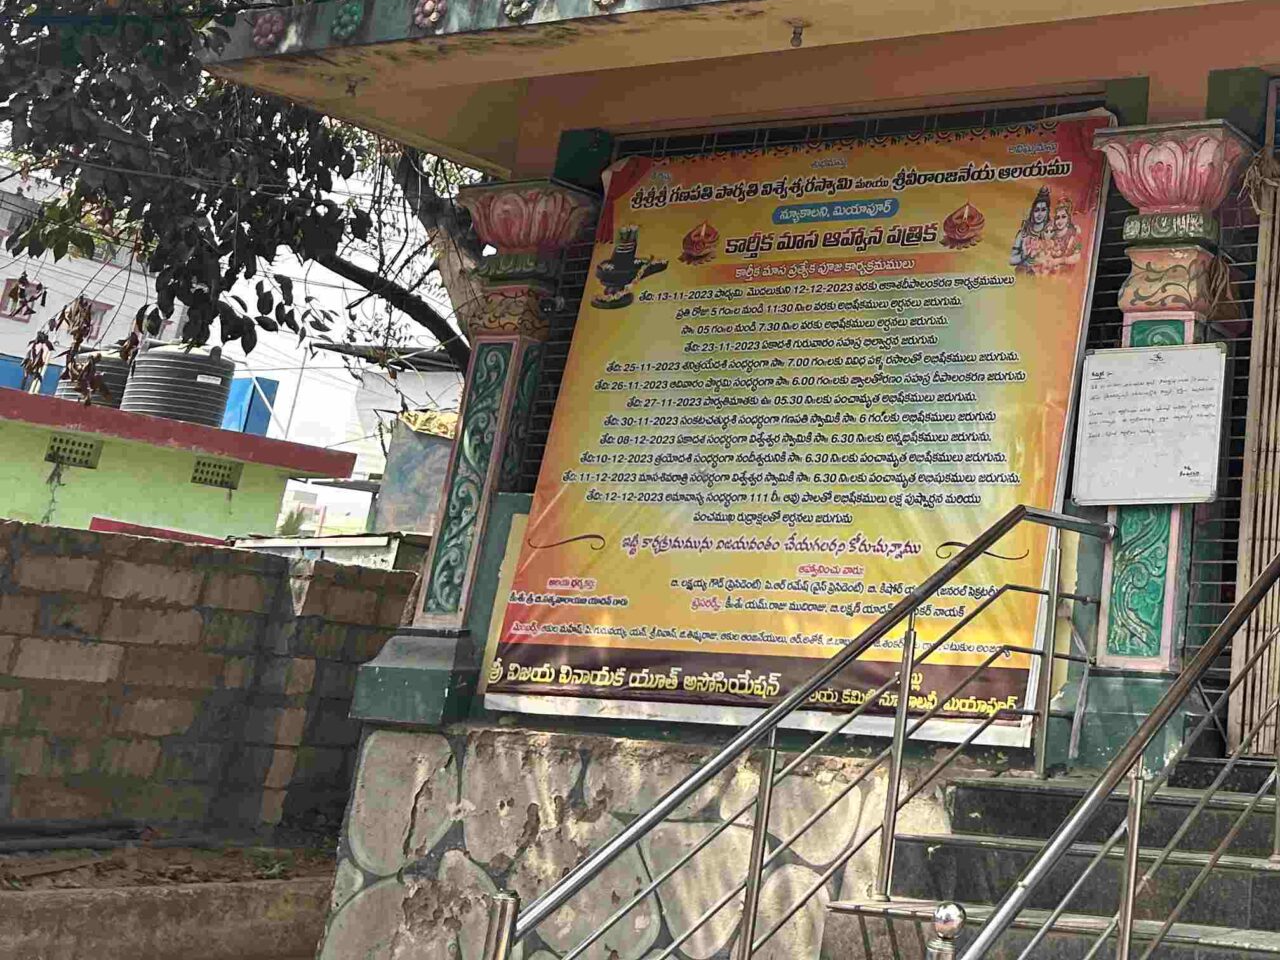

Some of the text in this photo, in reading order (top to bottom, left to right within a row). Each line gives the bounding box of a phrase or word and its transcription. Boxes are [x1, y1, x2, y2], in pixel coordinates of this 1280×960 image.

[670, 183, 712, 202] గణపతి
[714, 180, 758, 203] పార్వతి
[854, 176, 888, 189] మరియు
[998, 156, 1071, 179] ఆలయము
[832, 199, 892, 219] మియాపూర్
[776, 230, 819, 251] మాస
[822, 225, 884, 253] ఆహ్వాన
[886, 221, 938, 247] పత్రిక
[762, 266, 786, 276] మాస
[657, 290, 712, 300] 13-11-2023
[794, 283, 852, 293] 12-12-2023
[766, 303, 793, 312] 11:30
[697, 325, 709, 333] 05
[758, 322, 780, 330] 7.30
[703, 342, 759, 351] 23-11-2023
[623, 362, 680, 371] 25-11-2023
[787, 358, 809, 367] 7.00
[610, 381, 668, 390] 26-11-2023
[792, 376, 814, 385] 6.00
[643, 397, 701, 407] 27-11-2023
[774, 395, 802, 404] 05.30
[620, 417, 678, 426] 30-11-2023
[858, 414, 866, 422] 6
[616, 435, 674, 444] 08-12-2023
[830, 433, 854, 442] 6.30
[805, 453, 828, 462] 6.30
[579, 473, 636, 481] 11-12-2023
[813, 473, 836, 482] 6.30
[604, 493, 662, 501] 12-12-2023
[749, 494, 768, 502] 111
[506, 661, 555, 683] విజయ
[558, 663, 625, 687] వినాయక
[628, 664, 682, 690] యూత్
[808, 687, 838, 703] లయ
